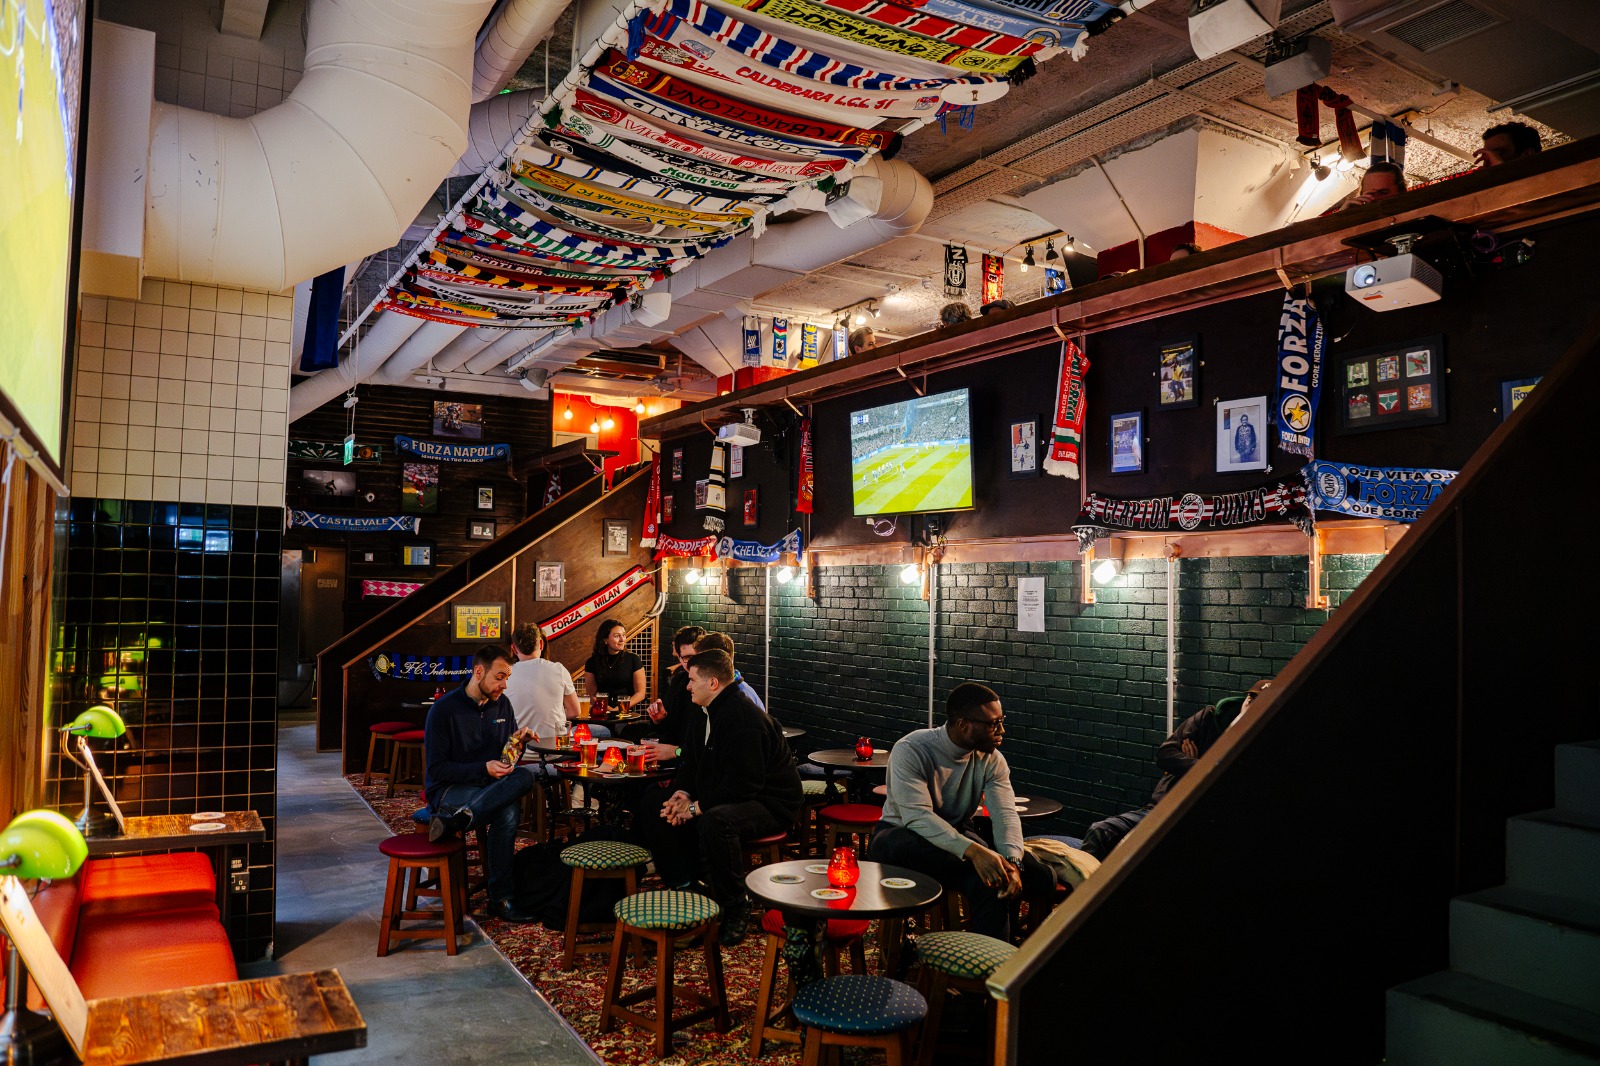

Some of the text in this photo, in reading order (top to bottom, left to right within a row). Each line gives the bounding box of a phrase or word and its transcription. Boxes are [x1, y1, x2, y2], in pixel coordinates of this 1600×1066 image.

[787, 6, 928, 55] DORTMUND
[952, 8, 1005, 30] CITY
[735, 66, 834, 104] CALDERARA
[622, 98, 821, 155] SCOTLAND
[740, 159, 802, 175] PARK
[577, 188, 593, 197] FC
[595, 194, 622, 207] Park
[470, 254, 543, 277] SCOTLAND
[1280, 298, 1309, 393] FORZA
[1311, 364, 1320, 388] CUORE
[411, 440, 495, 457] FORZA NAPOLI
[1281, 431, 1311, 446] FORZA INTER
[1348, 467, 1457, 480] OJE VITA OJ
[1359, 480, 1445, 506] FORZA
[1102, 496, 1173, 529] CLAPTON
[1209, 487, 1267, 527] PUNKS
[1351, 504, 1424, 519] OJE CORE
[319, 516, 388, 526] CASTLEVALE
[734, 545, 772, 557] CHELSEA
[593, 585, 621, 609] MILAN
[550, 610, 582, 633] FORZA
